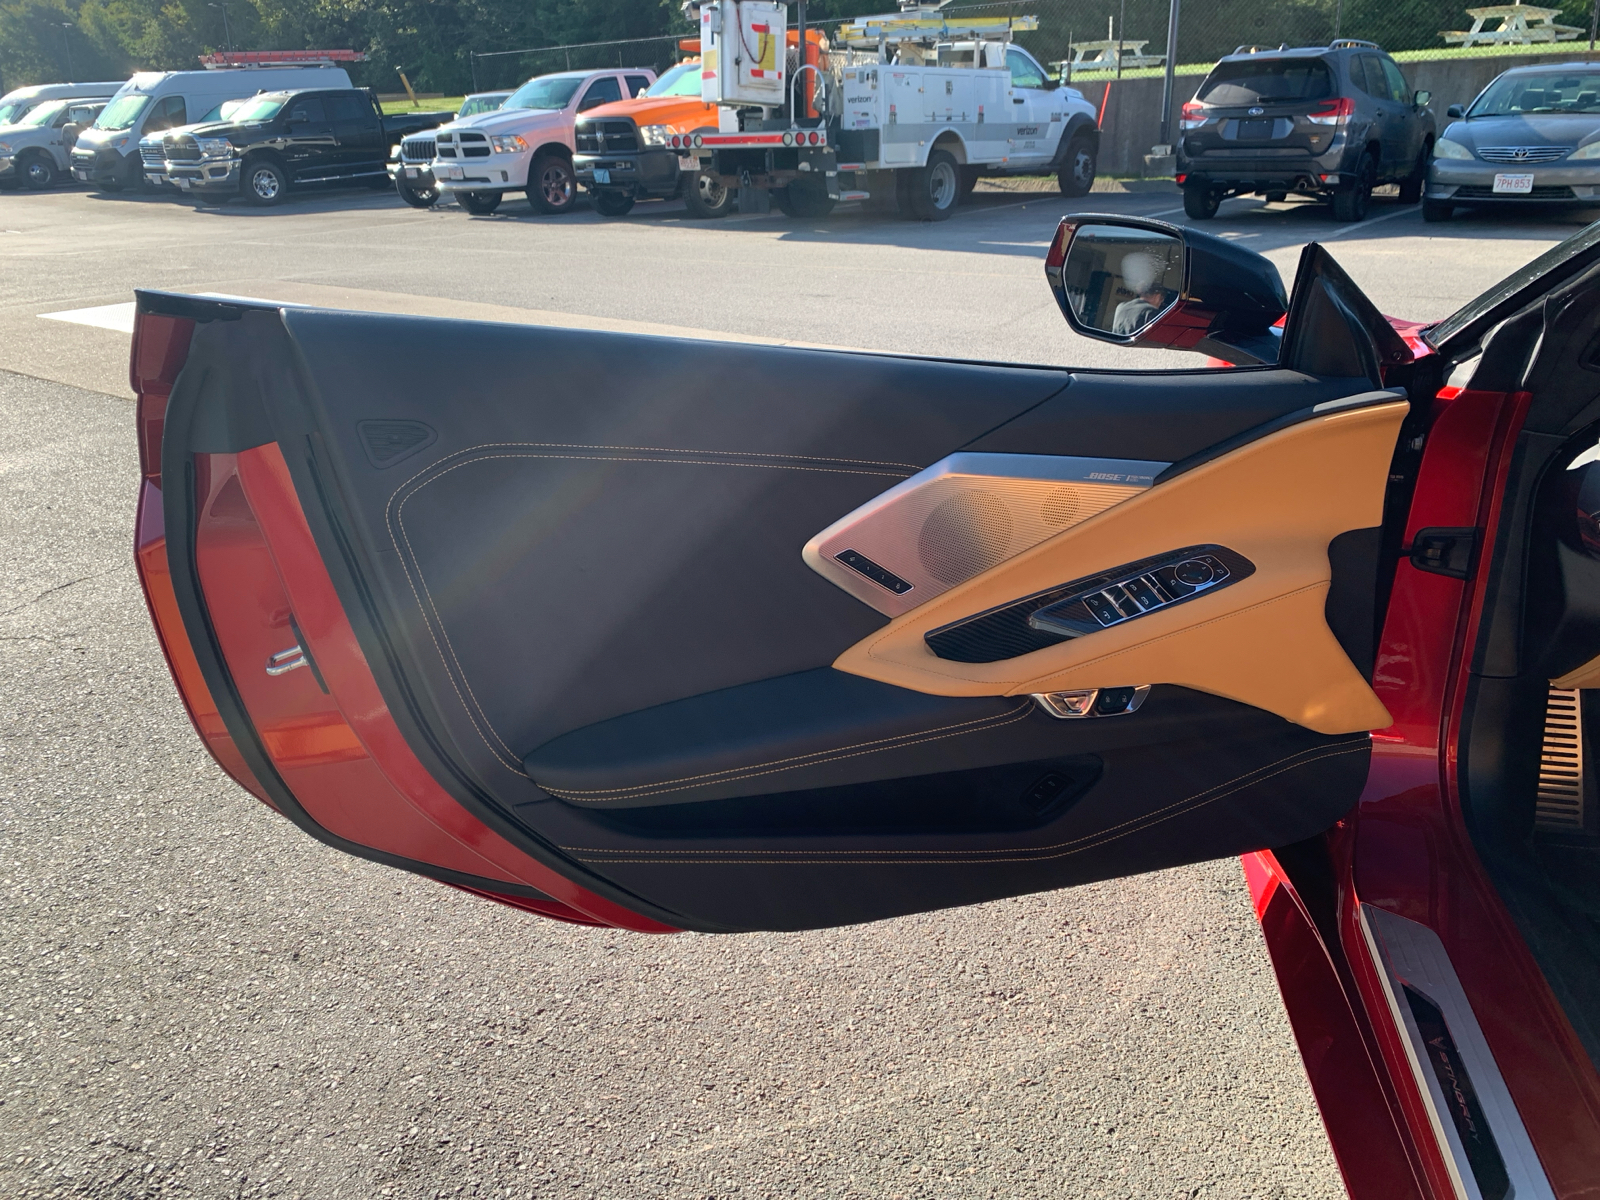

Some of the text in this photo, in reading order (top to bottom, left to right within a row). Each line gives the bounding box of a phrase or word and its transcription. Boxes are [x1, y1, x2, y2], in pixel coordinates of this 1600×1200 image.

[847, 95, 871, 104] verizon
[1017, 125, 1037, 135] verizon
[1496, 179, 1531, 189] 7PH 853
[1083, 472, 1126, 481] BOSE
[1439, 1051, 1481, 1145] STINGRAY
